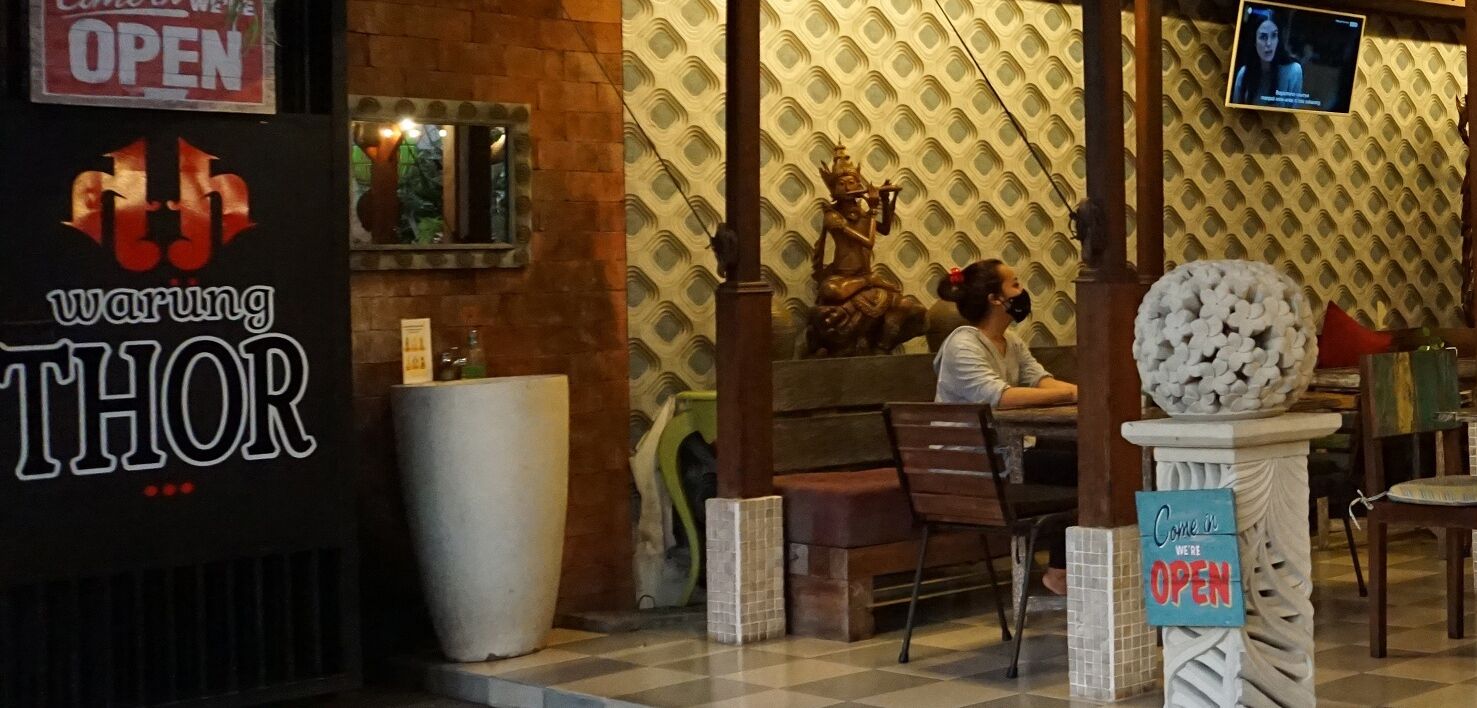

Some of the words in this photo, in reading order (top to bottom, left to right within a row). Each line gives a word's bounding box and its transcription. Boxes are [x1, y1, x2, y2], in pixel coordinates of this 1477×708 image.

[68, 18, 243, 91] OPEN
[0, 331, 317, 480] THOR
[1154, 504, 1199, 548] Come
[1204, 512, 1219, 534] in
[1175, 545, 1201, 556] WE'RE
[1151, 559, 1232, 608] OPEN
